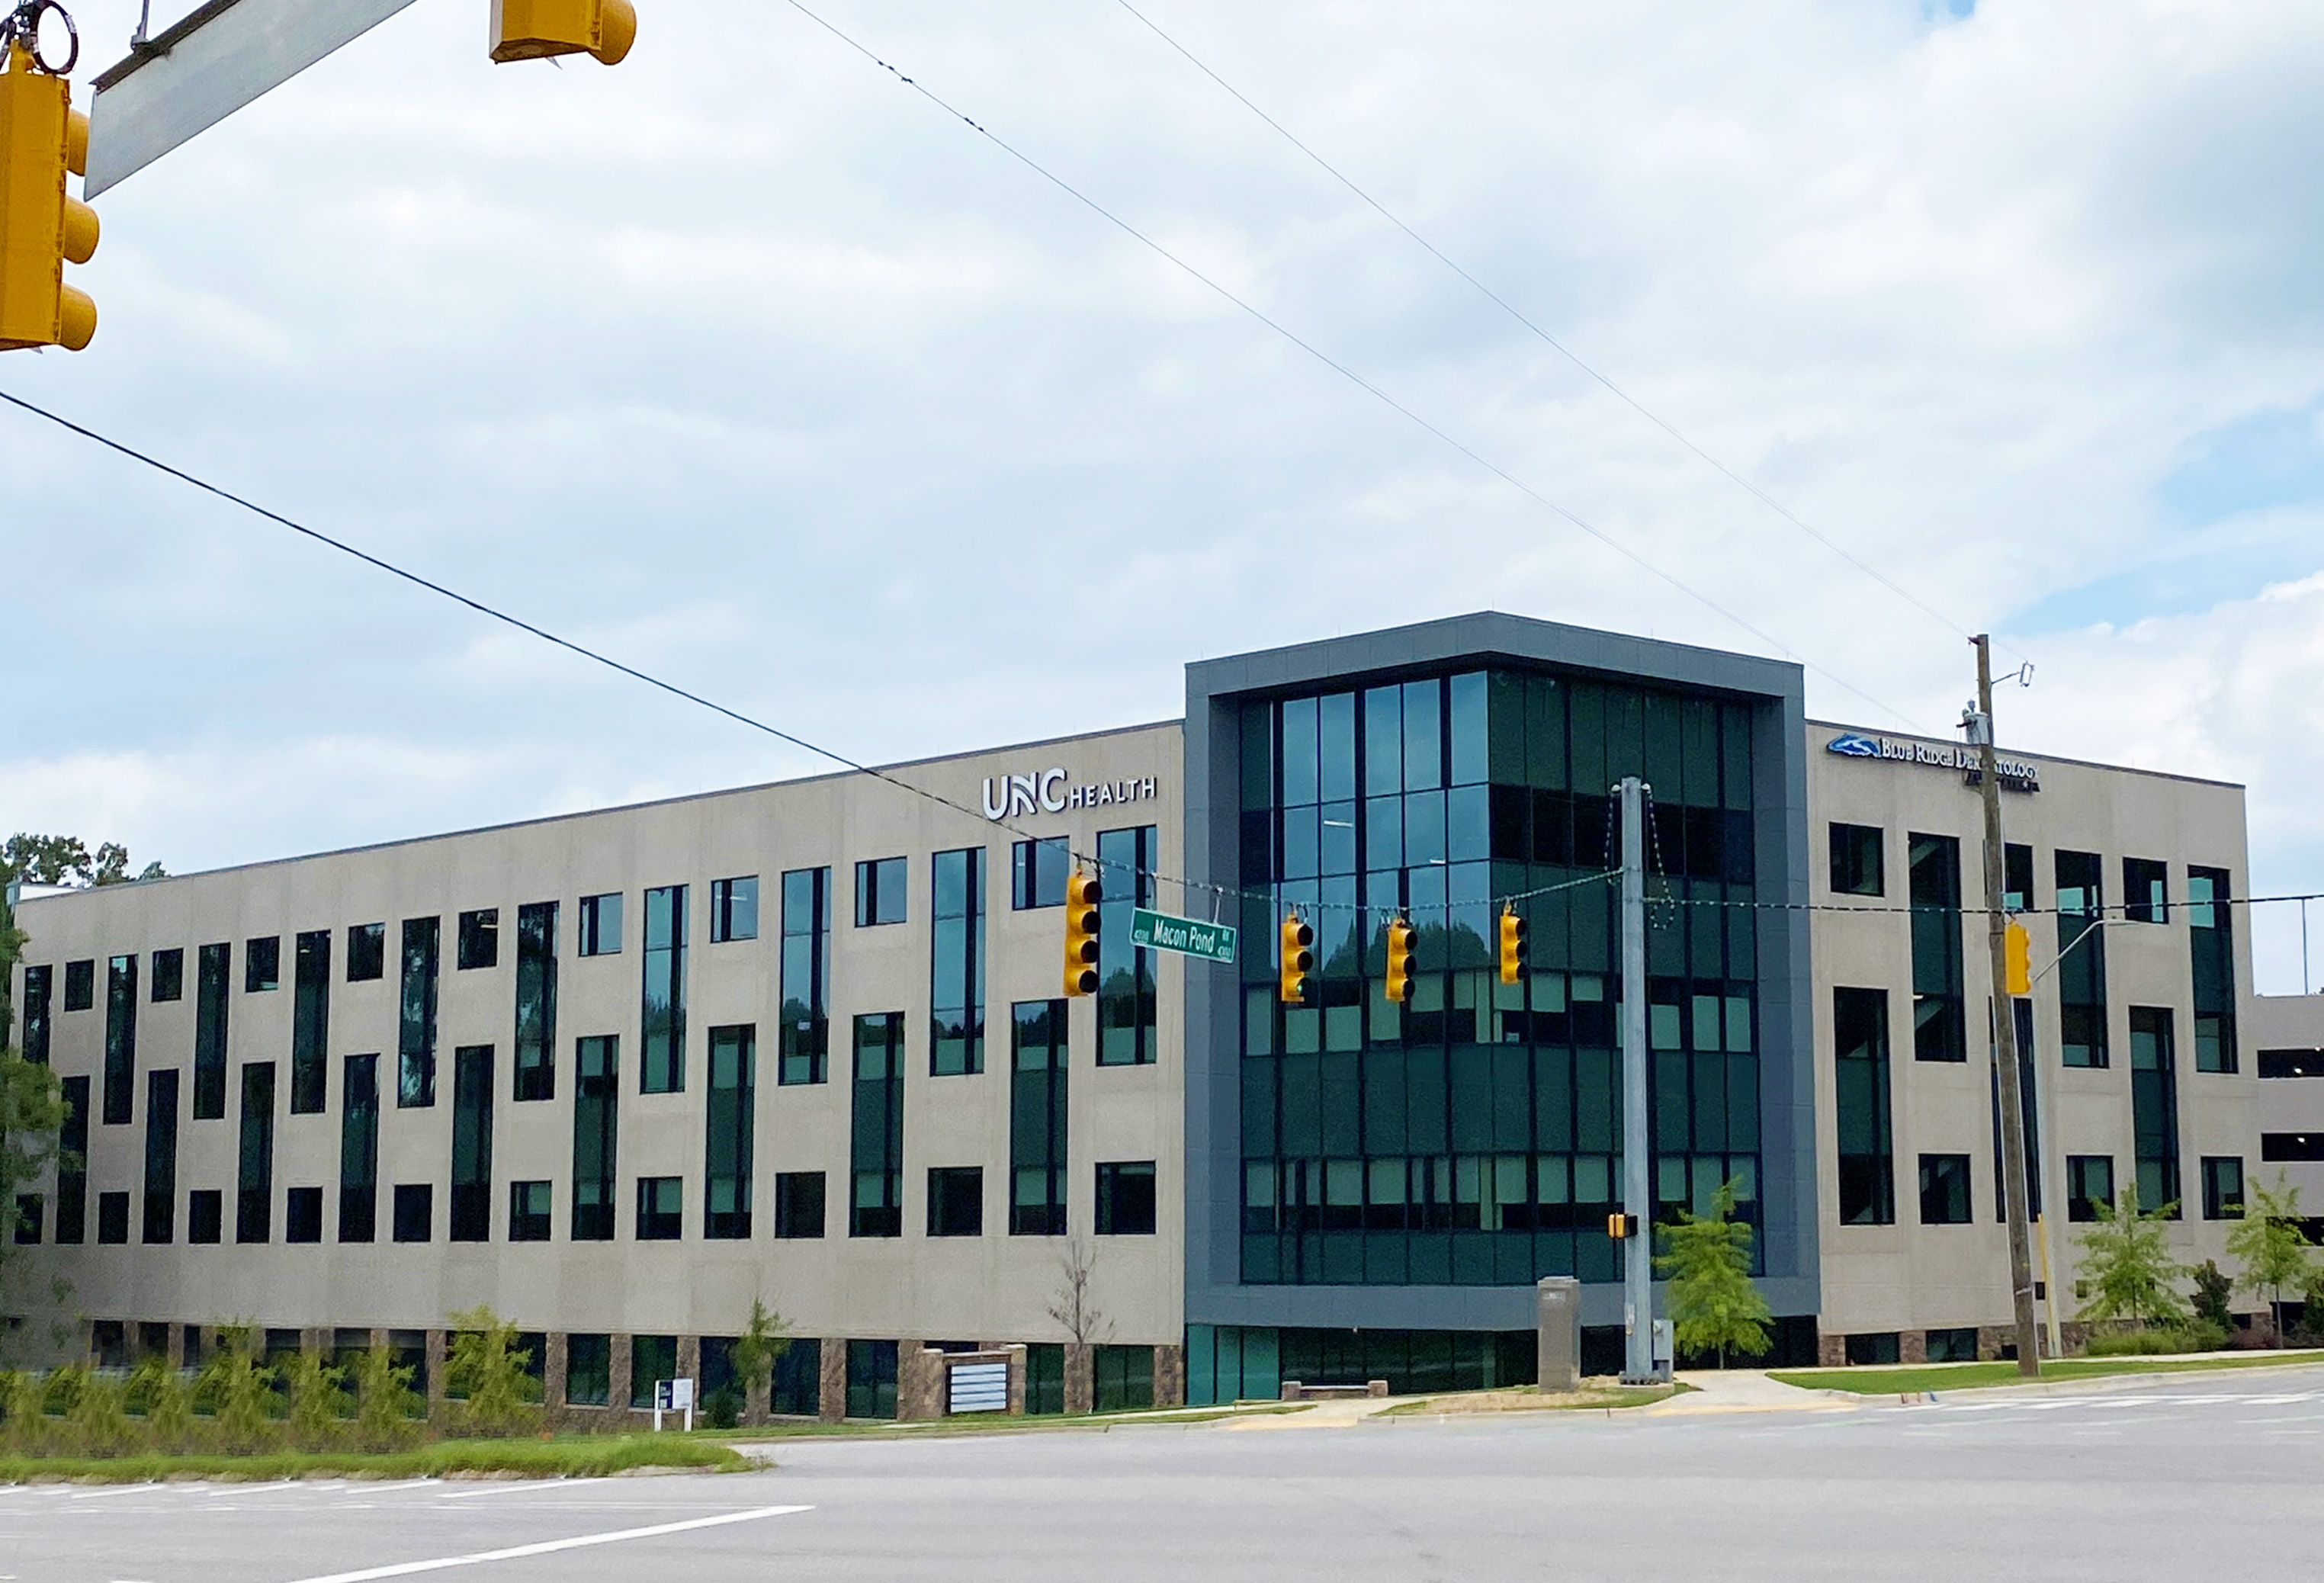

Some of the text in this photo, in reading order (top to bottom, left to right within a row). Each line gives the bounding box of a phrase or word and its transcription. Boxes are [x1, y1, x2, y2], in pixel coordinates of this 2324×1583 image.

[1880, 737, 2040, 779] BLUE RIDGE DERTOLOGY
[982, 766, 1157, 821] UNC HEALTH
[1153, 917, 1186, 948] Macon
[1189, 926, 1215, 953] Pond
